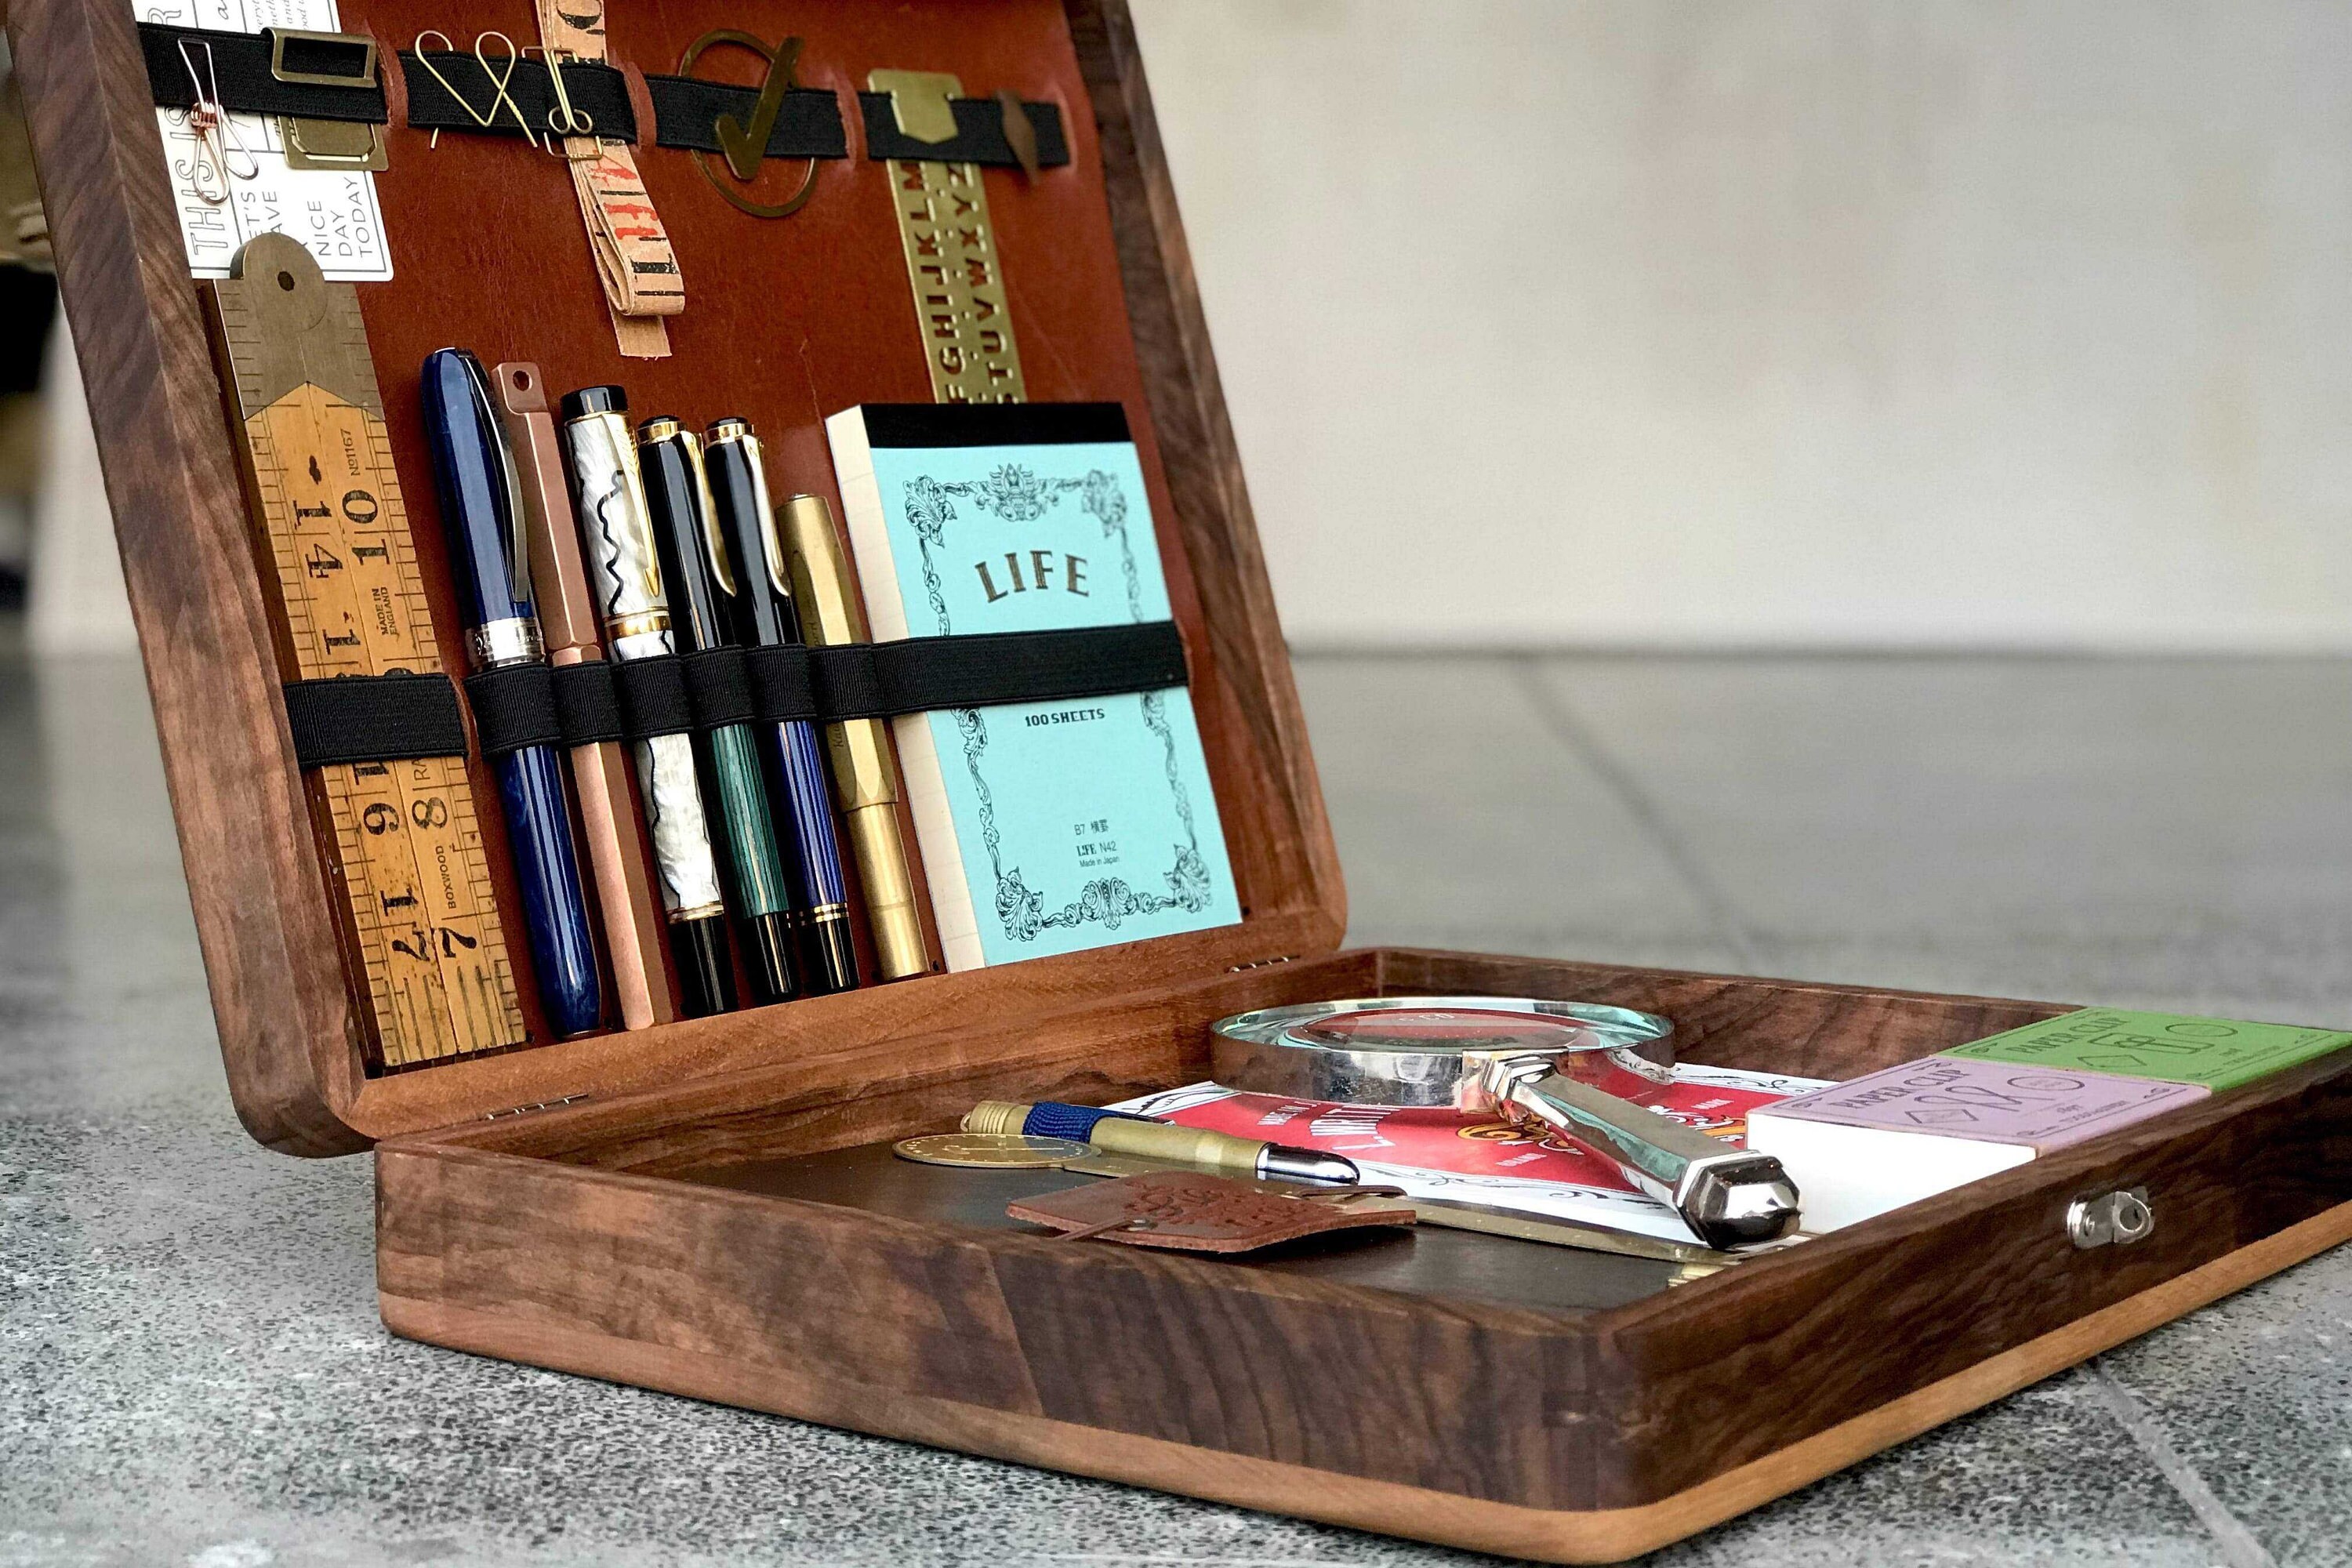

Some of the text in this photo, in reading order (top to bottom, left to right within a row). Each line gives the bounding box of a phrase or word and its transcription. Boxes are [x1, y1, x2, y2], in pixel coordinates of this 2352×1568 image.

[175, 159, 229, 256] THIS
[240, 191, 264, 238] ET'S
[262, 191, 283, 234] AVE
[307, 200, 332, 257] NICE
[345, 176, 373, 259] TODAY
[331, 209, 354, 257] DAY
[974, 549, 1091, 604] LIFE
[372, 587, 389, 636] MADE IN
[380, 586, 397, 636] ENGLAND
[1025, 708, 1105, 728] 100 SHEETS
[1074, 823, 1086, 836] B7
[1076, 840, 1118, 857] LIFE N42
[435, 845, 457, 910] BOXWOOD
[1104, 855, 1120, 866] Japan
[1828, 1069, 1973, 1109] PAPER CLIP
